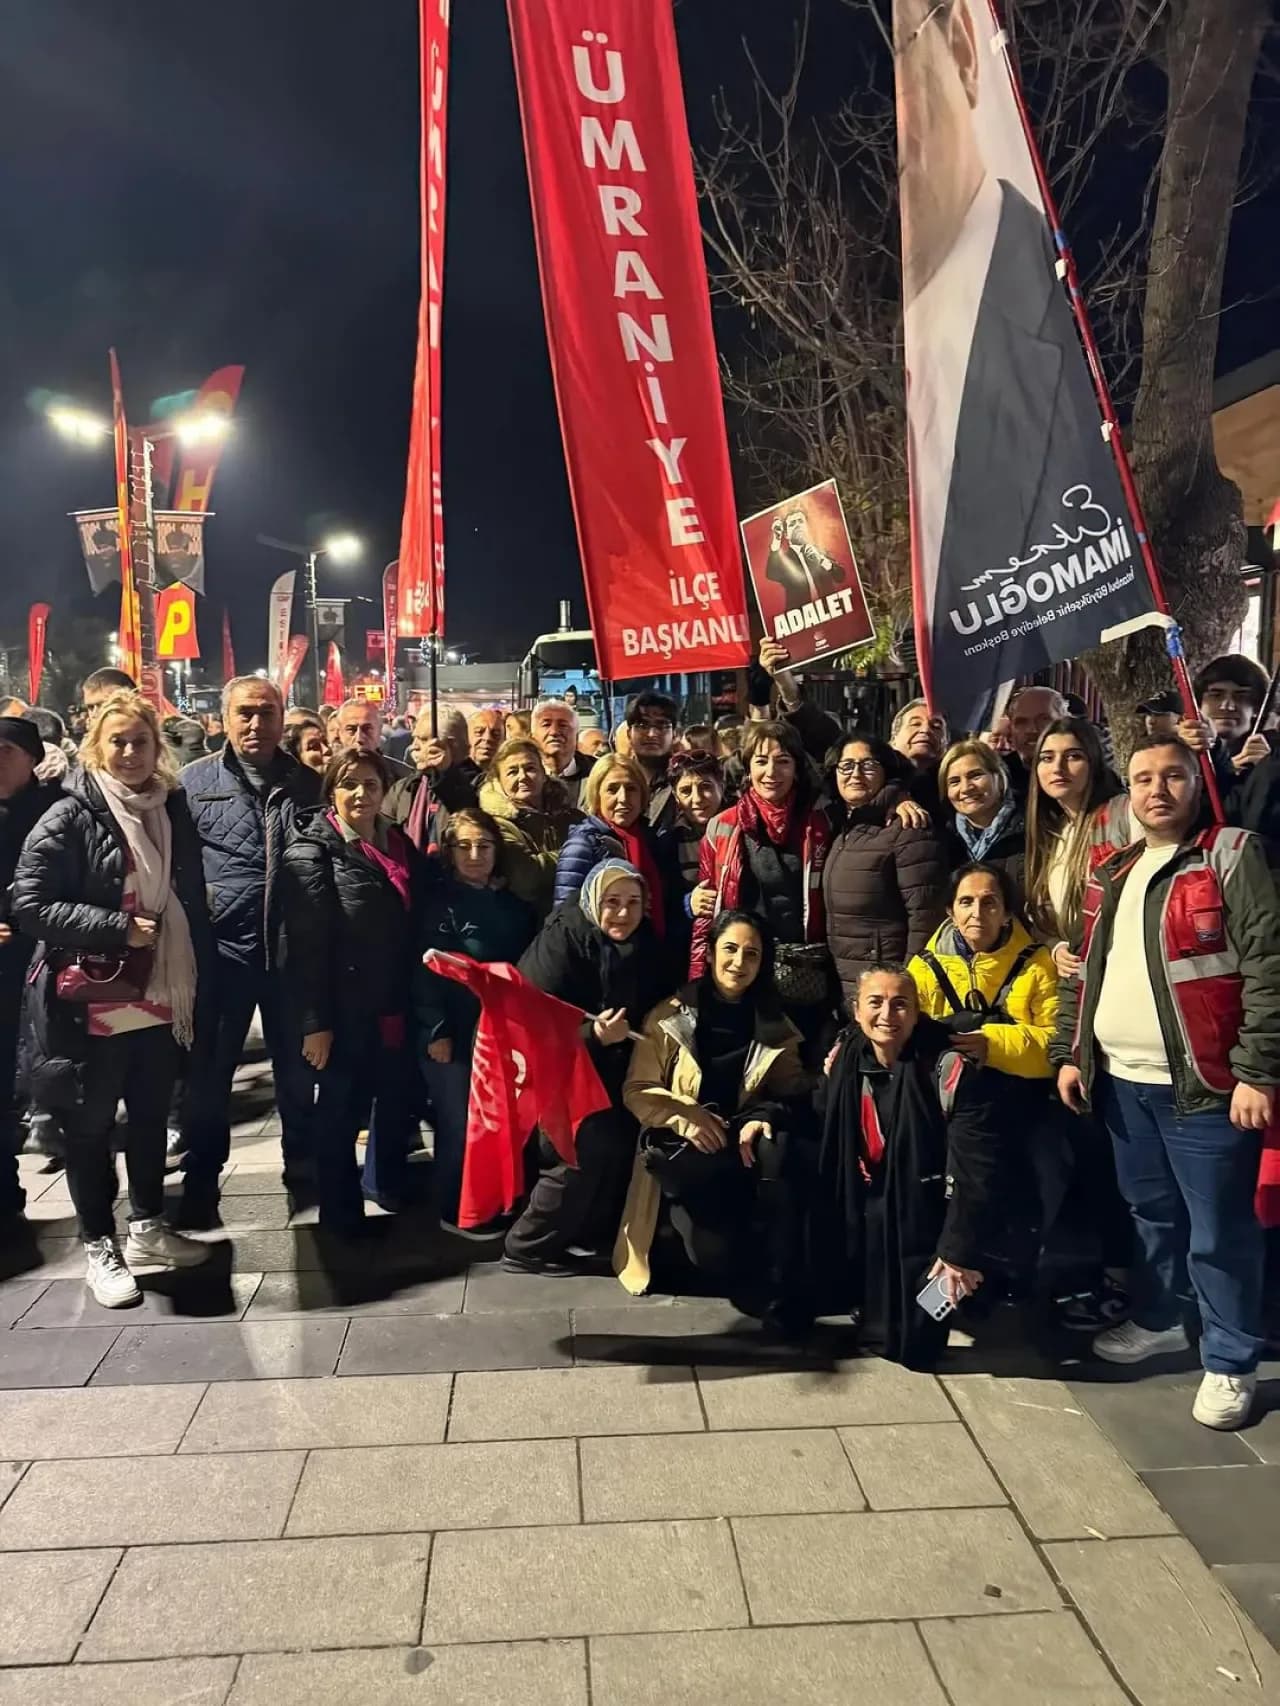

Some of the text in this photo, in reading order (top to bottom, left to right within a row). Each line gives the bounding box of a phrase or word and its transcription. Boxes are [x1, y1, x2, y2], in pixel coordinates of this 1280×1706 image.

[571, 30, 704, 547] ÜMRANİYE
[669, 569, 722, 610] İLÇE
[773, 588, 854, 640] ADALET
